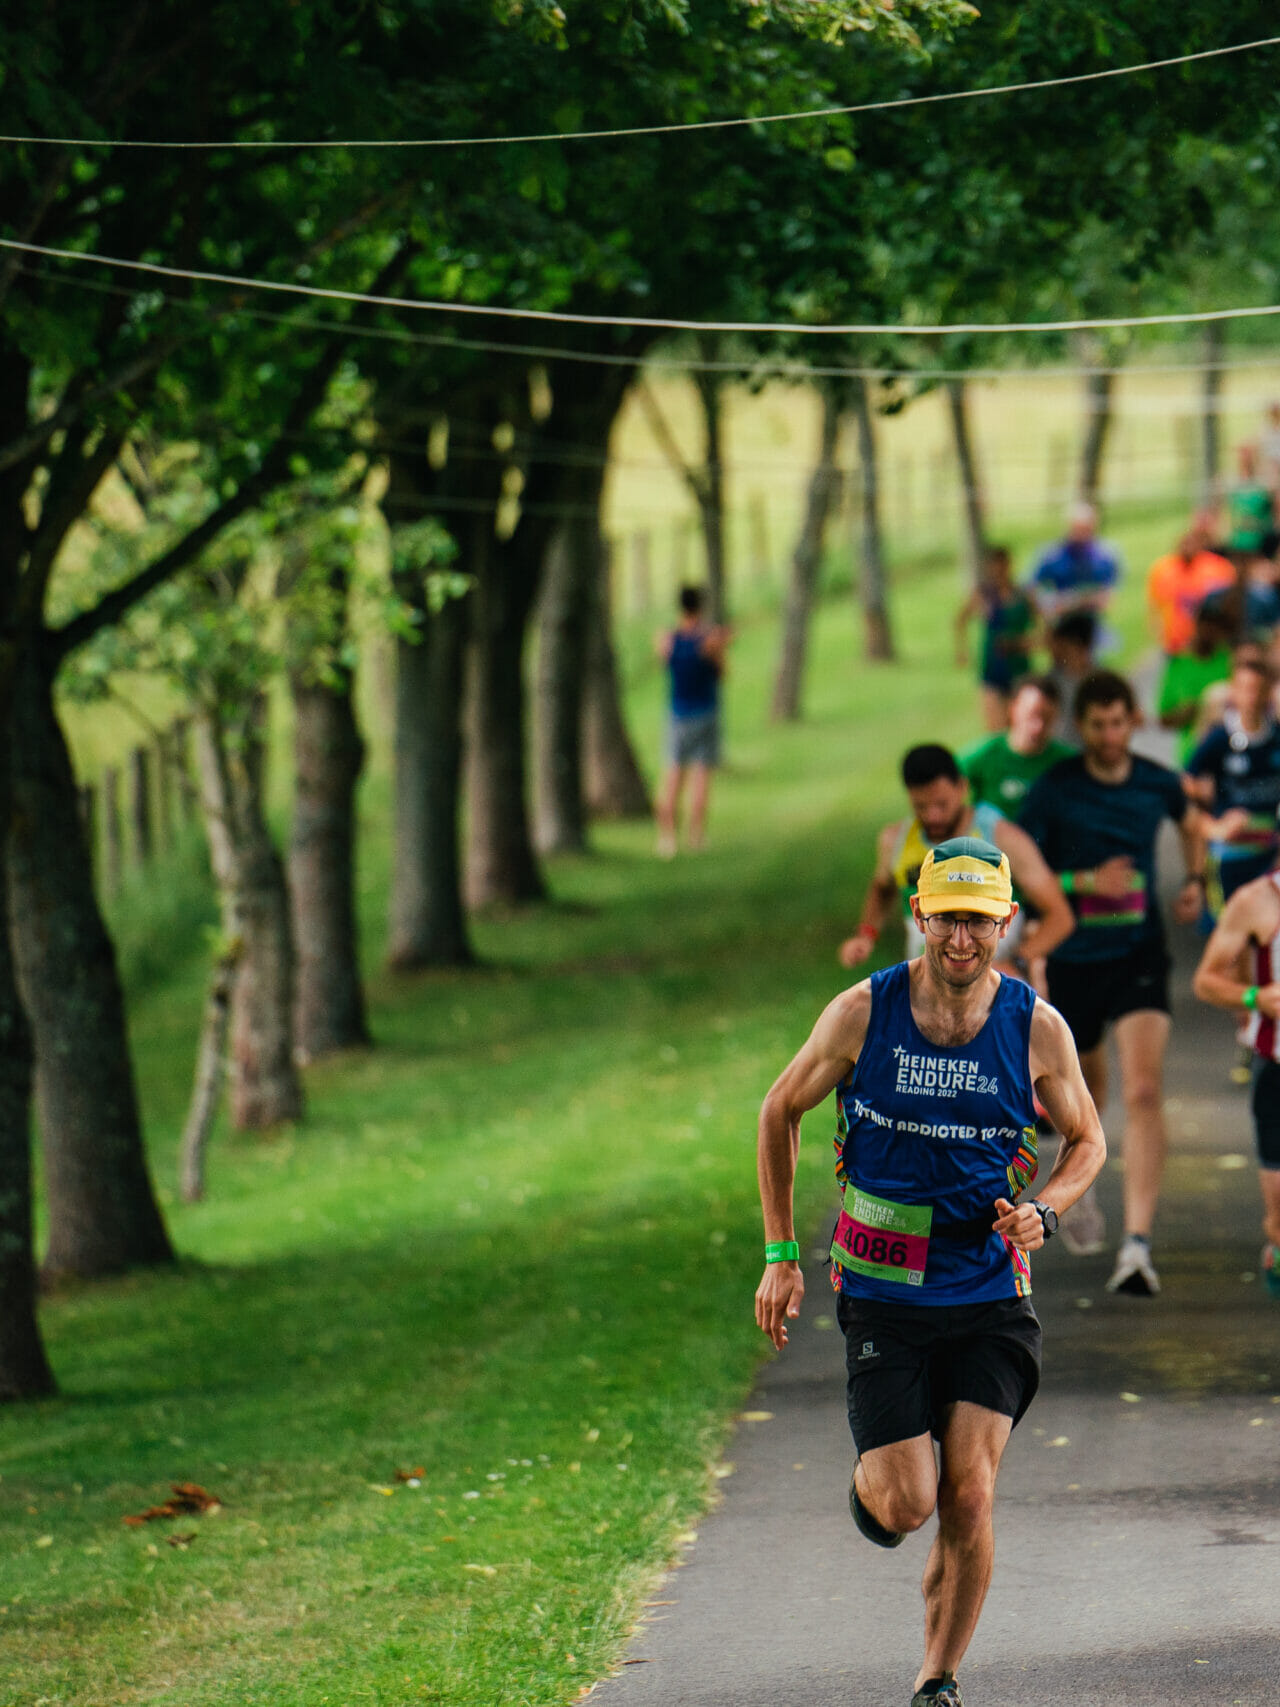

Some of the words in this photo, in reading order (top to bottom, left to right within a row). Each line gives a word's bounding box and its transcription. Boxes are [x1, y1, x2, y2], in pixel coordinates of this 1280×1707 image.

[900, 1054, 979, 1075] HEINEKEN
[895, 1084, 935, 1096] READING
[937, 1088, 958, 1098] 2022
[896, 1067, 999, 1095] ENDURE24
[896, 1120, 978, 1139] ADDICTED
[981, 1127, 997, 1141] TO
[855, 1196, 895, 1217] HEINEKEN
[844, 1225, 908, 1267] 4086
